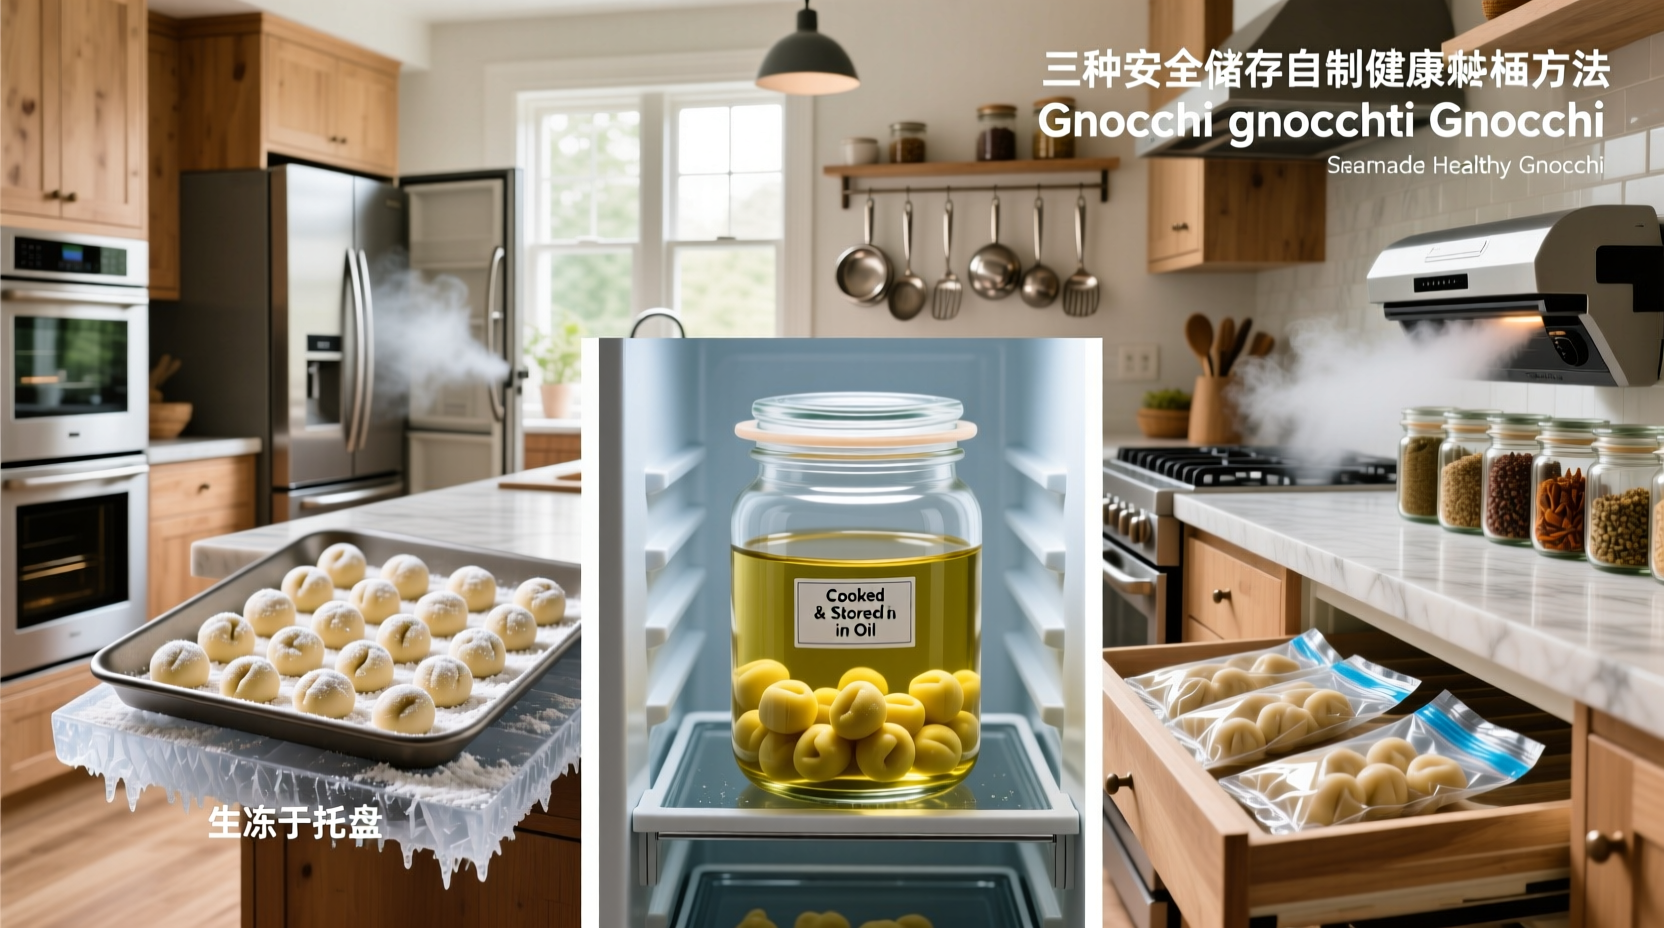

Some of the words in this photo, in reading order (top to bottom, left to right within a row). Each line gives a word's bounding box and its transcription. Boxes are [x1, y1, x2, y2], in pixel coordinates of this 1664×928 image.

[826, 587, 885, 602] Cooked
[814, 605, 826, 620] &
[831, 604, 884, 620] Stored
[836, 623, 850, 637] in
[854, 622, 876, 637] Oil
